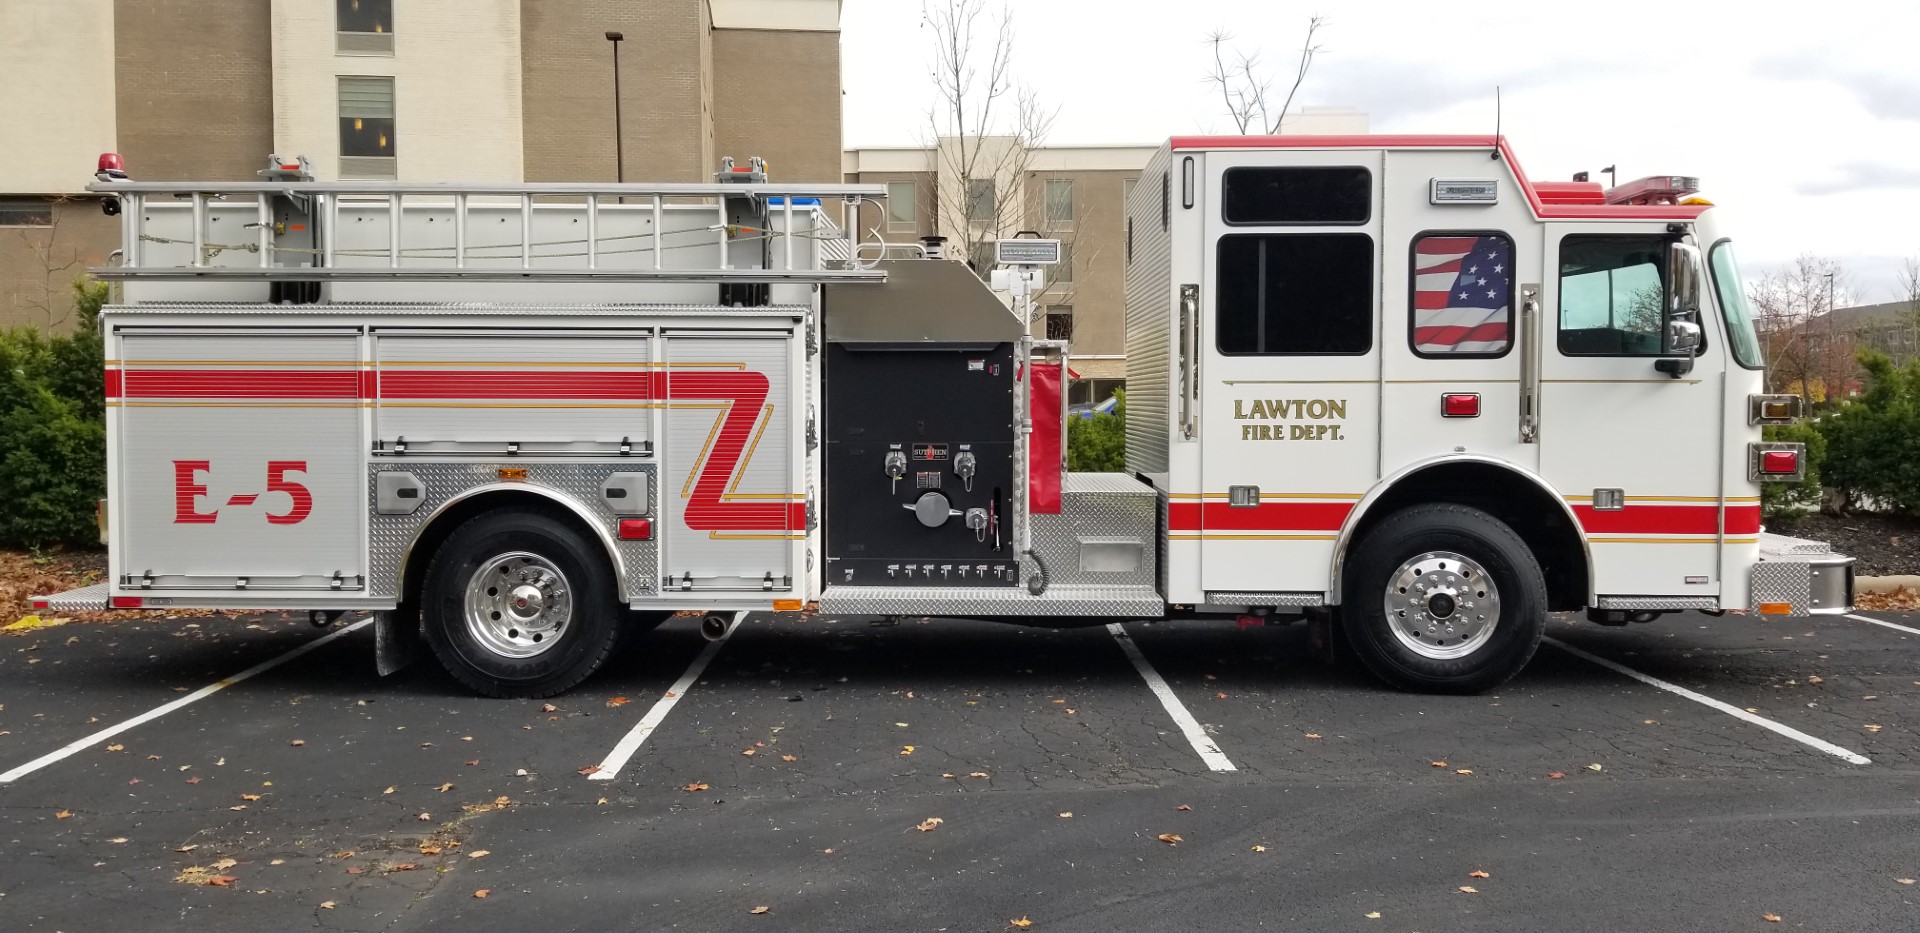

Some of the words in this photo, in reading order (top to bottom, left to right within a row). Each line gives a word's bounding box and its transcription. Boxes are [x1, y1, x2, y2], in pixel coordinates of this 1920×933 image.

[1234, 399, 1347, 420] LAWTON
[1242, 424, 1285, 441] FIRE
[1290, 424, 1345, 441] DEPT.
[914, 448, 947, 456] SUTPHEN
[172, 460, 313, 525] E-5
